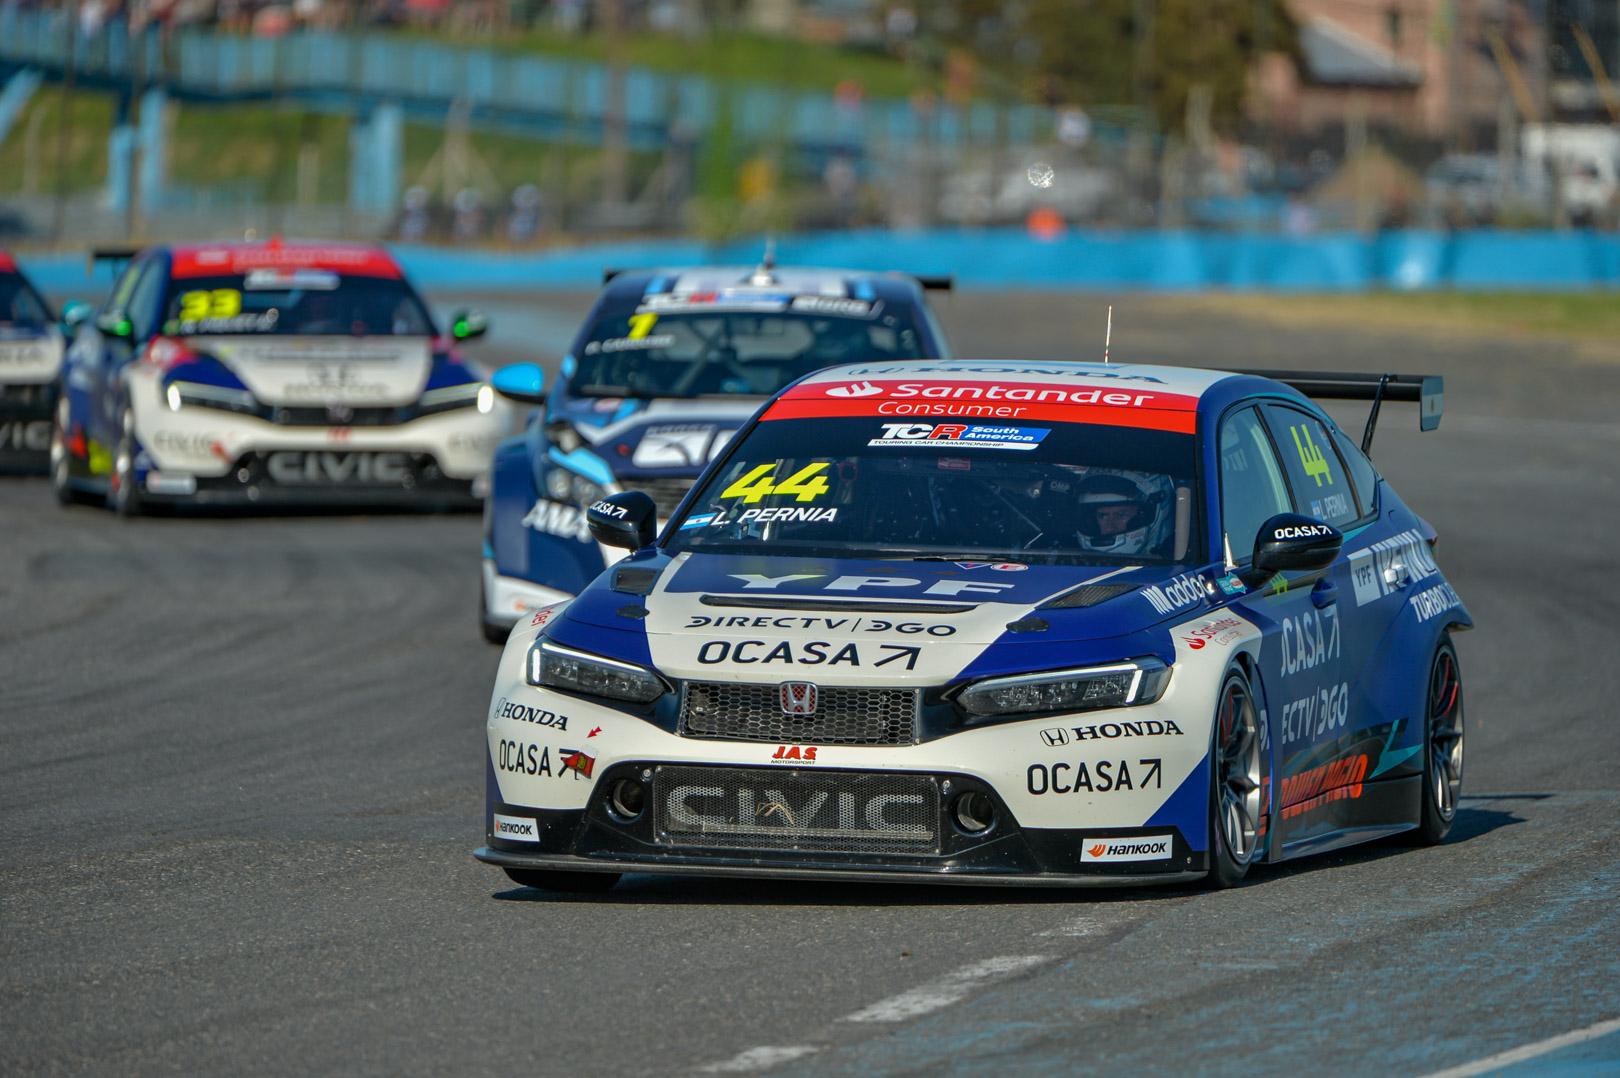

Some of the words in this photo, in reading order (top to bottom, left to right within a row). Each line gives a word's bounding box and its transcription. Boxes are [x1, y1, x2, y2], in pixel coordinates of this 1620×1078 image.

[181, 289, 242, 322] 33
[628, 312, 659, 340] 1
[910, 367, 1169, 385] HONDA
[890, 383, 1155, 407] Santander
[877, 401, 1027, 418] Consumer
[880, 423, 968, 441] TCR
[965, 433, 1034, 442] America
[969, 426, 1021, 435] South
[934, 440, 1005, 448] CHAMPIONSHIP
[1289, 424, 1334, 487] 44
[266, 450, 410, 483] CIVIC
[720, 462, 831, 504] 44
[711, 512, 730, 526] L.
[737, 507, 838, 523] PERNIA
[1274, 525, 1320, 540] OCASA
[728, 574, 1016, 596] YPF
[1355, 564, 1372, 588] YPF
[684, 616, 849, 631] DIRECTV
[696, 641, 860, 667] OCASA
[501, 702, 568, 731] HONDA
[1071, 720, 1184, 741] HONDA
[499, 739, 552, 778] OCASA
[772, 746, 818, 760] JAS
[1027, 760, 1133, 795] OCASA
[666, 786, 927, 833] CIVIC
